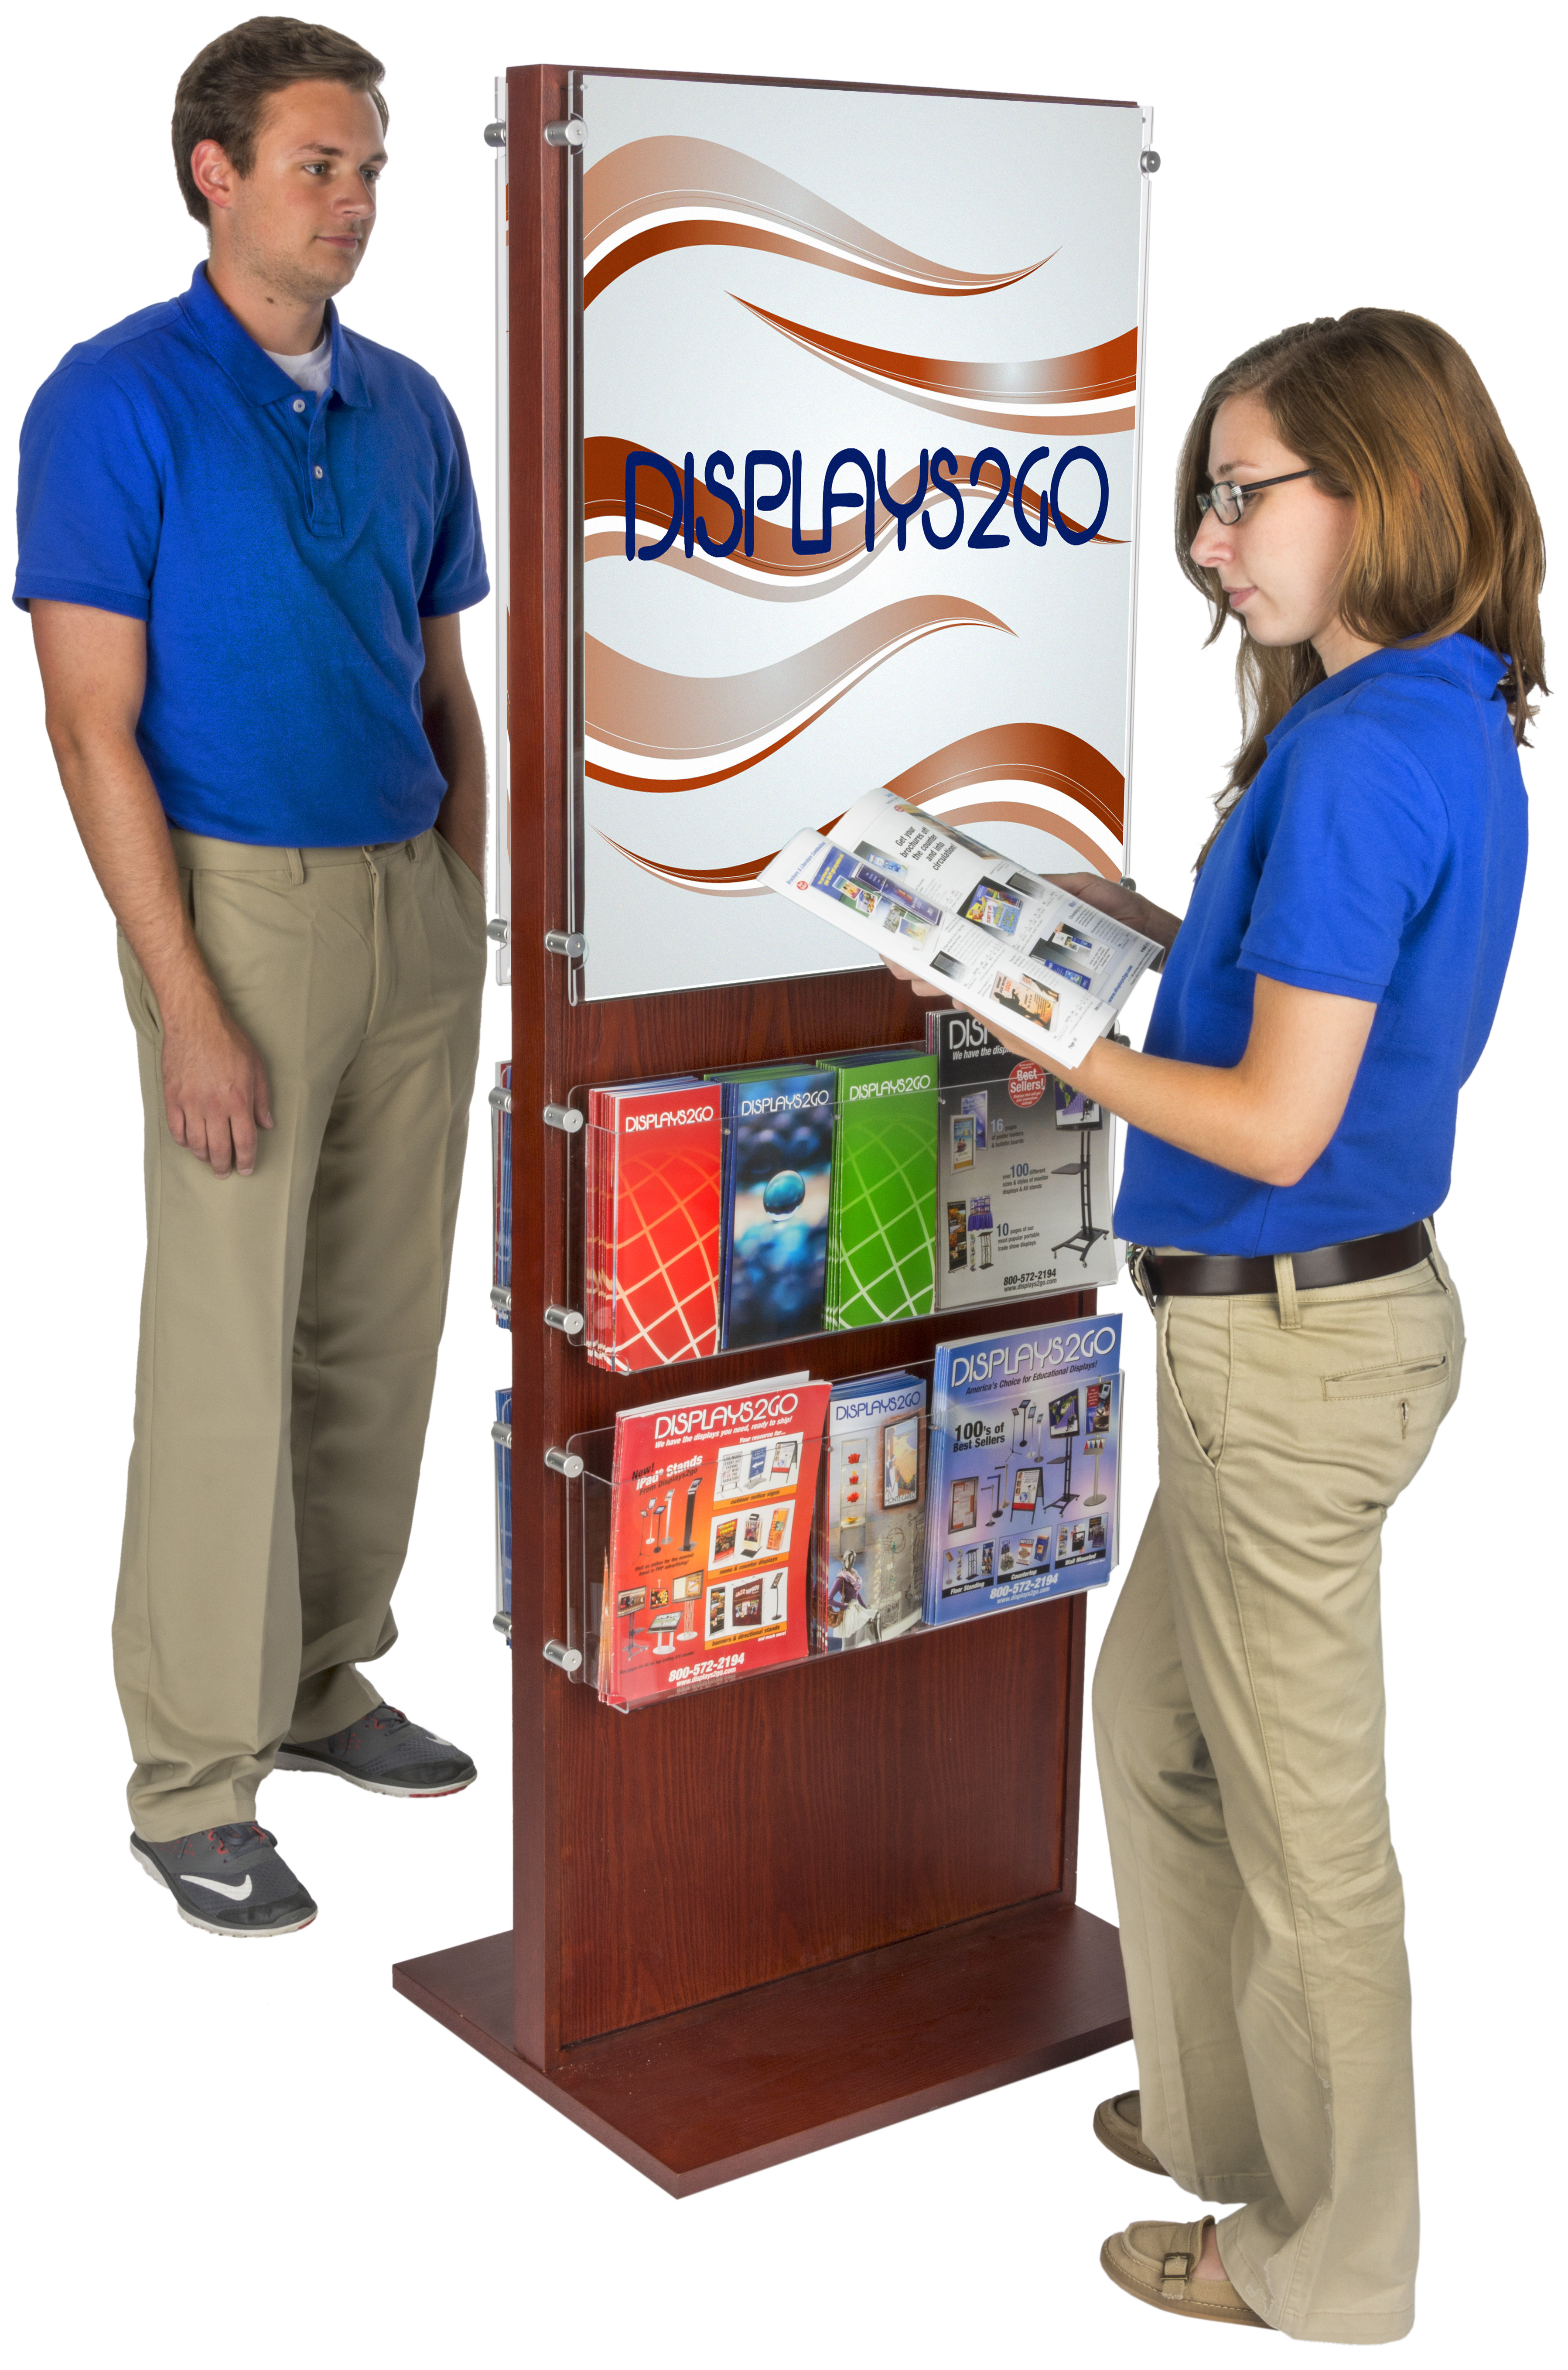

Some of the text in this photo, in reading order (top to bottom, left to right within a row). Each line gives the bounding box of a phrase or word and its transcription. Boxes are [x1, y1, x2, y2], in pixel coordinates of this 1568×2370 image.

[626, 446, 1109, 561] DISPLAYS2GO
[895, 827, 916, 846] Get your
[900, 833, 924, 858] brochures
[912, 834, 937, 860] the counter
[926, 841, 945, 862] and into
[933, 843, 957, 870] circulation!
[1107, 964, 1134, 1003] www.displays2go.com
[953, 1051, 962, 1060] We
[964, 1049, 979, 1059] have
[981, 1047, 991, 1056] the
[1017, 1068, 1037, 1081] Best
[850, 1075, 930, 1101] DISPLAYS2GO
[1011, 1078, 1045, 1093] Sellers!
[741, 1090, 829, 1116] DISPLAYS2GO
[625, 1107, 713, 1132] DISPLAYS2GO
[991, 1118, 1003, 1132] 16
[1011, 1163, 1028, 1178] 100
[997, 1223, 1008, 1237] 10
[1004, 1269, 1056, 1286] 800-572-2194
[1004, 1279, 1057, 1292] www.displays2go.com
[951, 1327, 1116, 1388] DISPLAYS2GO
[966, 1382, 998, 1395] America's
[999, 1379, 1021, 1390] Choice
[1032, 1368, 1068, 1381] Educational
[1069, 1361, 1098, 1373] Displays!
[836, 1391, 920, 1420] DISPLAYS2GO
[655, 1393, 798, 1440] DISPLAYS2GO
[694, 1430, 719, 1442] displays
[733, 1424, 749, 1433] need,
[751, 1421, 768, 1430] ready
[776, 1416, 793, 1426] ship!
[752, 1433, 773, 1441] resource
[955, 1420, 1004, 1441] 100's of
[953, 1435, 1005, 1452] Best Sellers
[632, 1463, 654, 1480] New!
[666, 1455, 703, 1477] Stands
[639, 1484, 656, 1495] From
[658, 1468, 697, 1488] Displays2go
[731, 1496, 749, 1505] outdoor
[739, 1561, 758, 1570] counter
[758, 1557, 778, 1565] displays
[1076, 1553, 1097, 1563] Mounted
[1011, 1570, 1037, 1580] Countertop
[963, 1582, 985, 1591] Standing
[990, 1573, 1058, 1599] 800-572-2194
[997, 1587, 1050, 1604] www.displays2go.com
[712, 1636, 731, 1646] banners
[738, 1629, 763, 1639] directional
[668, 1652, 745, 1682] 800-572-2194
[676, 1667, 736, 1687] www.displays2go.com
